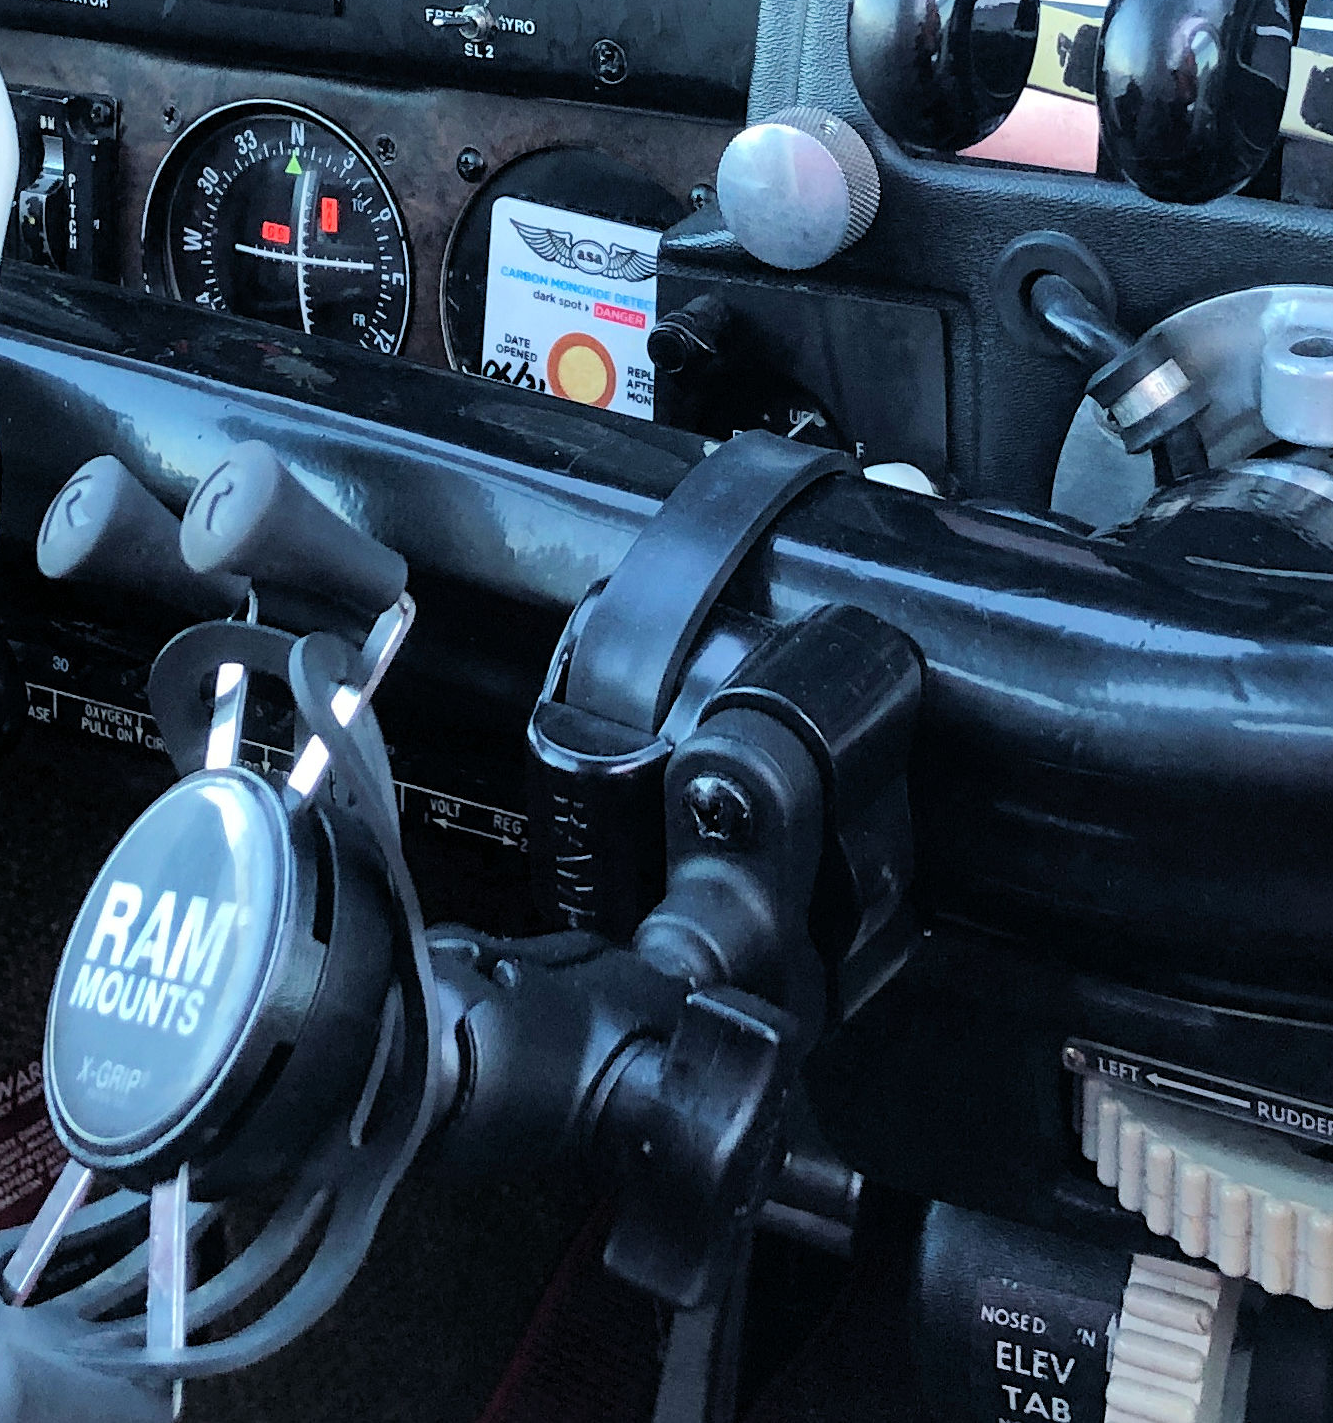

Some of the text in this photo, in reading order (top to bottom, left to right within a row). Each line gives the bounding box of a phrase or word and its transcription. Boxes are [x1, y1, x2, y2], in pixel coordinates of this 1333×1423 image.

[234, 128, 258, 156] 33
[196, 165, 220, 197] 30
[68, 173, 79, 249] PITCH
[577, 250, 603, 266] asa
[500, 266, 611, 300] CARBON MONOXIDE
[533, 290, 644, 327] dark spot DANGER
[496, 344, 537, 362] OPENED
[505, 333, 530, 348] DATE
[82, 718, 133, 741] PULL ON
[84, 705, 132, 726] OXYGEN
[430, 798, 521, 833] VOLT REG
[86, 882, 237, 986] RAM
[70, 965, 205, 1036] MOUNTS
[1099, 1058, 1139, 1082] LEFT
[996, 1341, 1076, 1382] ELEV
[1001, 1386, 1071, 1423] TAB
